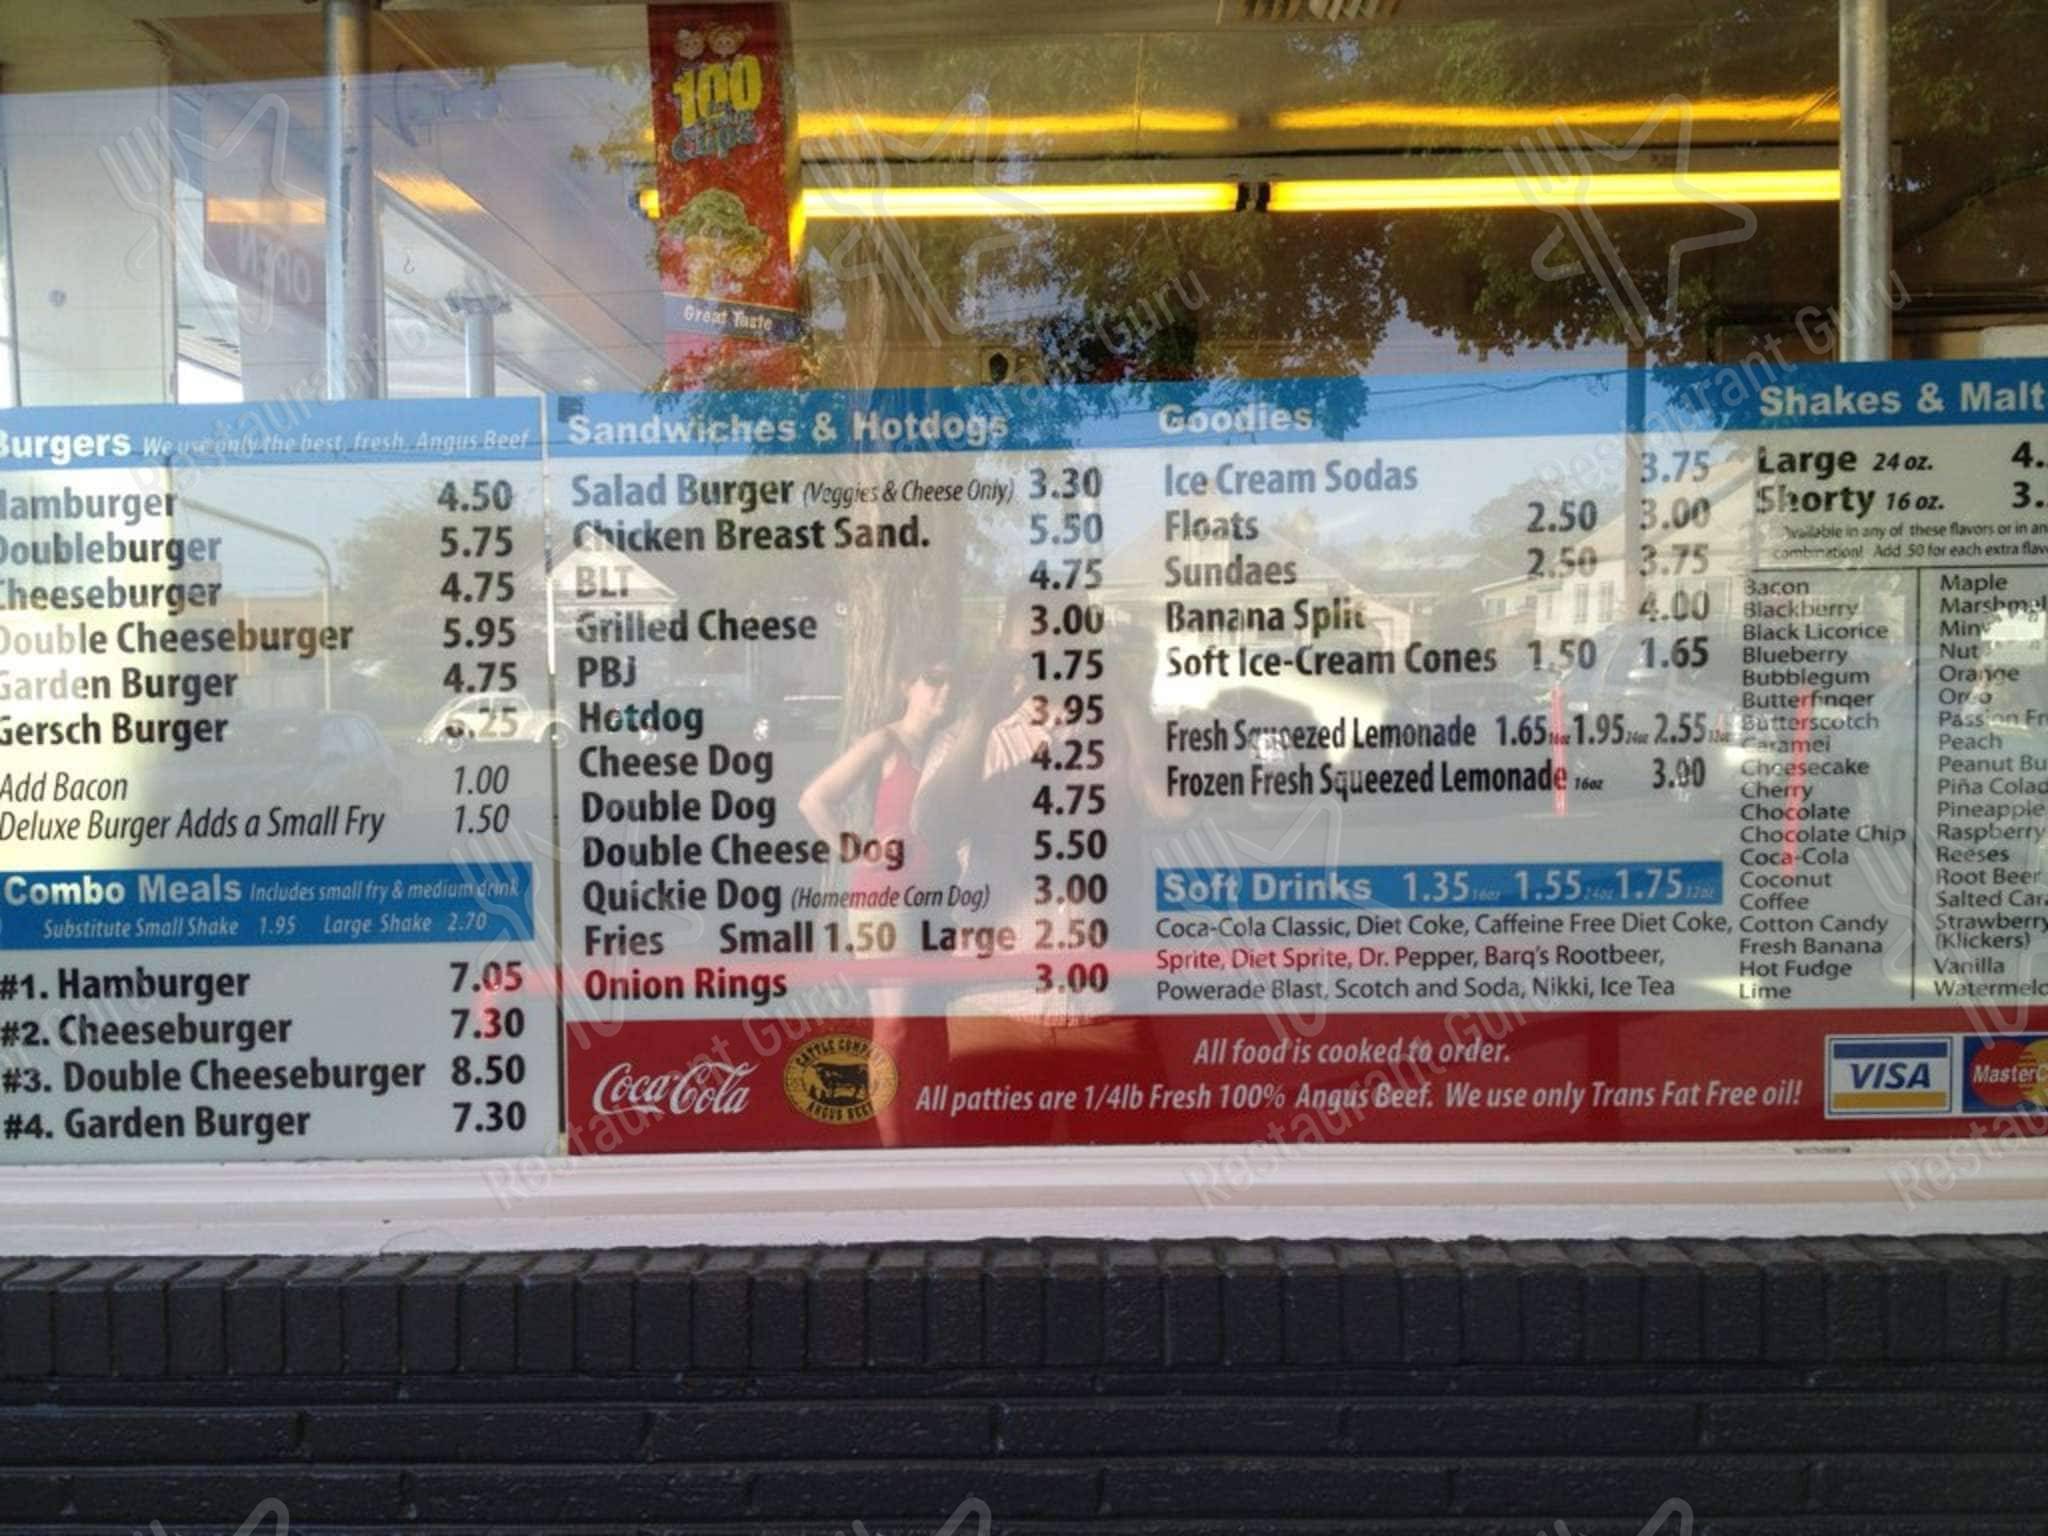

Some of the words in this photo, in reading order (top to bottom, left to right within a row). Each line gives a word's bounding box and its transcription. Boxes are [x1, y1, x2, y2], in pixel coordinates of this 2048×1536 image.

[672, 55, 763, 129] 100
[683, 305, 727, 325] Great
[732, 309, 772, 331] Taste
[1760, 385, 1902, 417] Shakes
[1917, 382, 1945, 414] &
[569, 414, 796, 445] Sandwiches
[811, 411, 837, 442] &
[854, 410, 1008, 447] Hotdogs
[1159, 403, 1313, 434] Goodies
[1757, 446, 1857, 480] Large
[1872, 452, 1901, 472] 24
[1904, 455, 1934, 472] oz.
[571, 472, 666, 507] Salad
[677, 474, 794, 514] Burger
[882, 480, 897, 502] &
[902, 480, 963, 502] Cheese
[1029, 467, 1102, 499] 3.30
[439, 526, 514, 558] 5.75
[1939, 572, 2008, 596] Maple
[117, 620, 353, 658] Cheeseburger
[443, 618, 516, 648] 5.95
[1743, 624, 1803, 642] Black
[1806, 622, 1889, 640] Licorice
[1167, 647, 1229, 677] Soft
[1240, 642, 1395, 676] Ice-Cream
[1405, 640, 1497, 674] Cones
[1527, 638, 1597, 672] 1.50
[1640, 635, 1710, 669] 1.65
[1743, 647, 1847, 665] Blueberry
[1742, 668, 1870, 689] Bubblegum
[1939, 665, 2020, 686] Orange
[0, 772, 46, 802] Add
[52, 771, 128, 802] Bacon
[453, 765, 510, 796] 1.00
[1166, 765, 1245, 798] Frozen
[1250, 763, 1314, 795] Fresh
[1320, 761, 1435, 802] Squeezed
[1441, 758, 1568, 793] Lemonade
[0, 810, 82, 841] Deluxe
[87, 809, 171, 847] Burger
[176, 807, 239, 839] Adds
[243, 815, 260, 837] a
[267, 806, 340, 838] Small
[345, 806, 385, 843] Fry
[453, 804, 510, 834] 1.50
[1740, 803, 1850, 822] Chocolate
[583, 835, 701, 867] Double
[712, 834, 830, 864] Cheese
[840, 831, 905, 870] Dog
[1033, 829, 1107, 861] 5.50
[1740, 825, 1850, 844] Chocolate
[1855, 824, 1906, 846] Chip
[1936, 846, 2009, 863] Reeses
[3, 875, 126, 906] Combo
[138, 874, 242, 902] Meals
[251, 882, 315, 902] Includes
[319, 881, 363, 900] small
[367, 880, 388, 904] fry
[392, 879, 402, 899] &
[408, 879, 474, 899] medium
[476, 878, 519, 897] drink
[583, 880, 707, 914] Quickie
[718, 877, 782, 914] Dog
[791, 885, 900, 913] (Homemade
[903, 885, 943, 908] Corn
[948, 884, 990, 912] Dog)
[1034, 874, 1107, 906] 3.00
[1163, 874, 1239, 901] Soft
[1252, 870, 1372, 900] Drinks
[1740, 871, 1832, 889] Coconut
[1740, 892, 1810, 911] Coffee
[44, 917, 131, 939] Substitute
[135, 916, 184, 938] Small
[187, 915, 239, 937] Shake
[259, 915, 297, 935] 1.95
[324, 916, 371, 938] Large
[380, 913, 433, 933] Shake
[448, 912, 487, 932] 2.70
[1156, 917, 1268, 939] Coca-Cola
[1273, 915, 1352, 940] Classic,
[1356, 914, 1403, 937] Diet
[1408, 914, 1469, 939] Coke,
[1475, 911, 1564, 936] Caffeine
[1570, 912, 1616, 934] Free
[1622, 911, 1667, 933] Diet
[1672, 909, 1734, 935] Coke,
[1740, 915, 1815, 934] Cotton
[1820, 914, 1888, 934] Candy
[1740, 937, 1796, 956] Fresh
[1803, 938, 1883, 955] Banana
[1935, 930, 2031, 951] (Klickers)
[1157, 948, 1227, 977] Sprite,
[1232, 947, 1277, 970] Diet
[1283, 946, 1354, 975] Sprite,
[1359, 946, 1390, 969] Dr.
[1395, 945, 1479, 974] Pepper,
[1556, 942, 1664, 969] Rootbeer,
[1740, 960, 1778, 978] Hot
[1785, 960, 1852, 981] Fudge
[1934, 957, 2005, 975] Vanilla
[0, 974, 49, 1000] #1.
[58, 966, 250, 1006] Hamburger
[450, 960, 523, 993] 7.05
[585, 970, 684, 1001] Onion
[695, 968, 787, 1005] Rings
[1034, 962, 1109, 994] 3.00
[1157, 979, 1266, 1004] Powerade
[1335, 977, 1409, 1001] Scotch
[1416, 977, 1459, 999] and
[1465, 977, 1527, 1002] Soda,
[1533, 975, 1596, 1000] Nikki,
[1600, 976, 1630, 998] Ice
[1635, 976, 1675, 997] Tea
[1740, 983, 1792, 1001] Lime
[1194, 1038, 1227, 1066] All
[1230, 1037, 1288, 1069] food
[1292, 1037, 1311, 1065] is
[1318, 1038, 1402, 1065] cooked
[1408, 1042, 1433, 1064] to
[1439, 1037, 1512, 1064] order.
[2, 1066, 52, 1093] #3.
[64, 1059, 181, 1092] Double
[191, 1056, 426, 1096] Cheeseburger
[451, 1054, 526, 1086] 8.50
[1852, 1062, 1931, 1089] VISA
[915, 1085, 947, 1111] All
[951, 1084, 1034, 1118] patties
[1039, 1091, 1078, 1110] are
[1083, 1083, 1143, 1113] 1/4lb
[1150, 1084, 1212, 1112] Fresh
[1218, 1083, 1286, 1111] 100%
[1294, 1083, 1370, 1116] Angus
[1375, 1082, 1435, 1110] Beef.
[1445, 1082, 1482, 1108] We
[1486, 1089, 1526, 1108] use
[1532, 1079, 1584, 1115] only
[1591, 1080, 1656, 1107] Trans
[1661, 1079, 1700, 1106] Fat
[1705, 1077, 1757, 1107] Free
[1763, 1077, 1803, 1106] oil!
